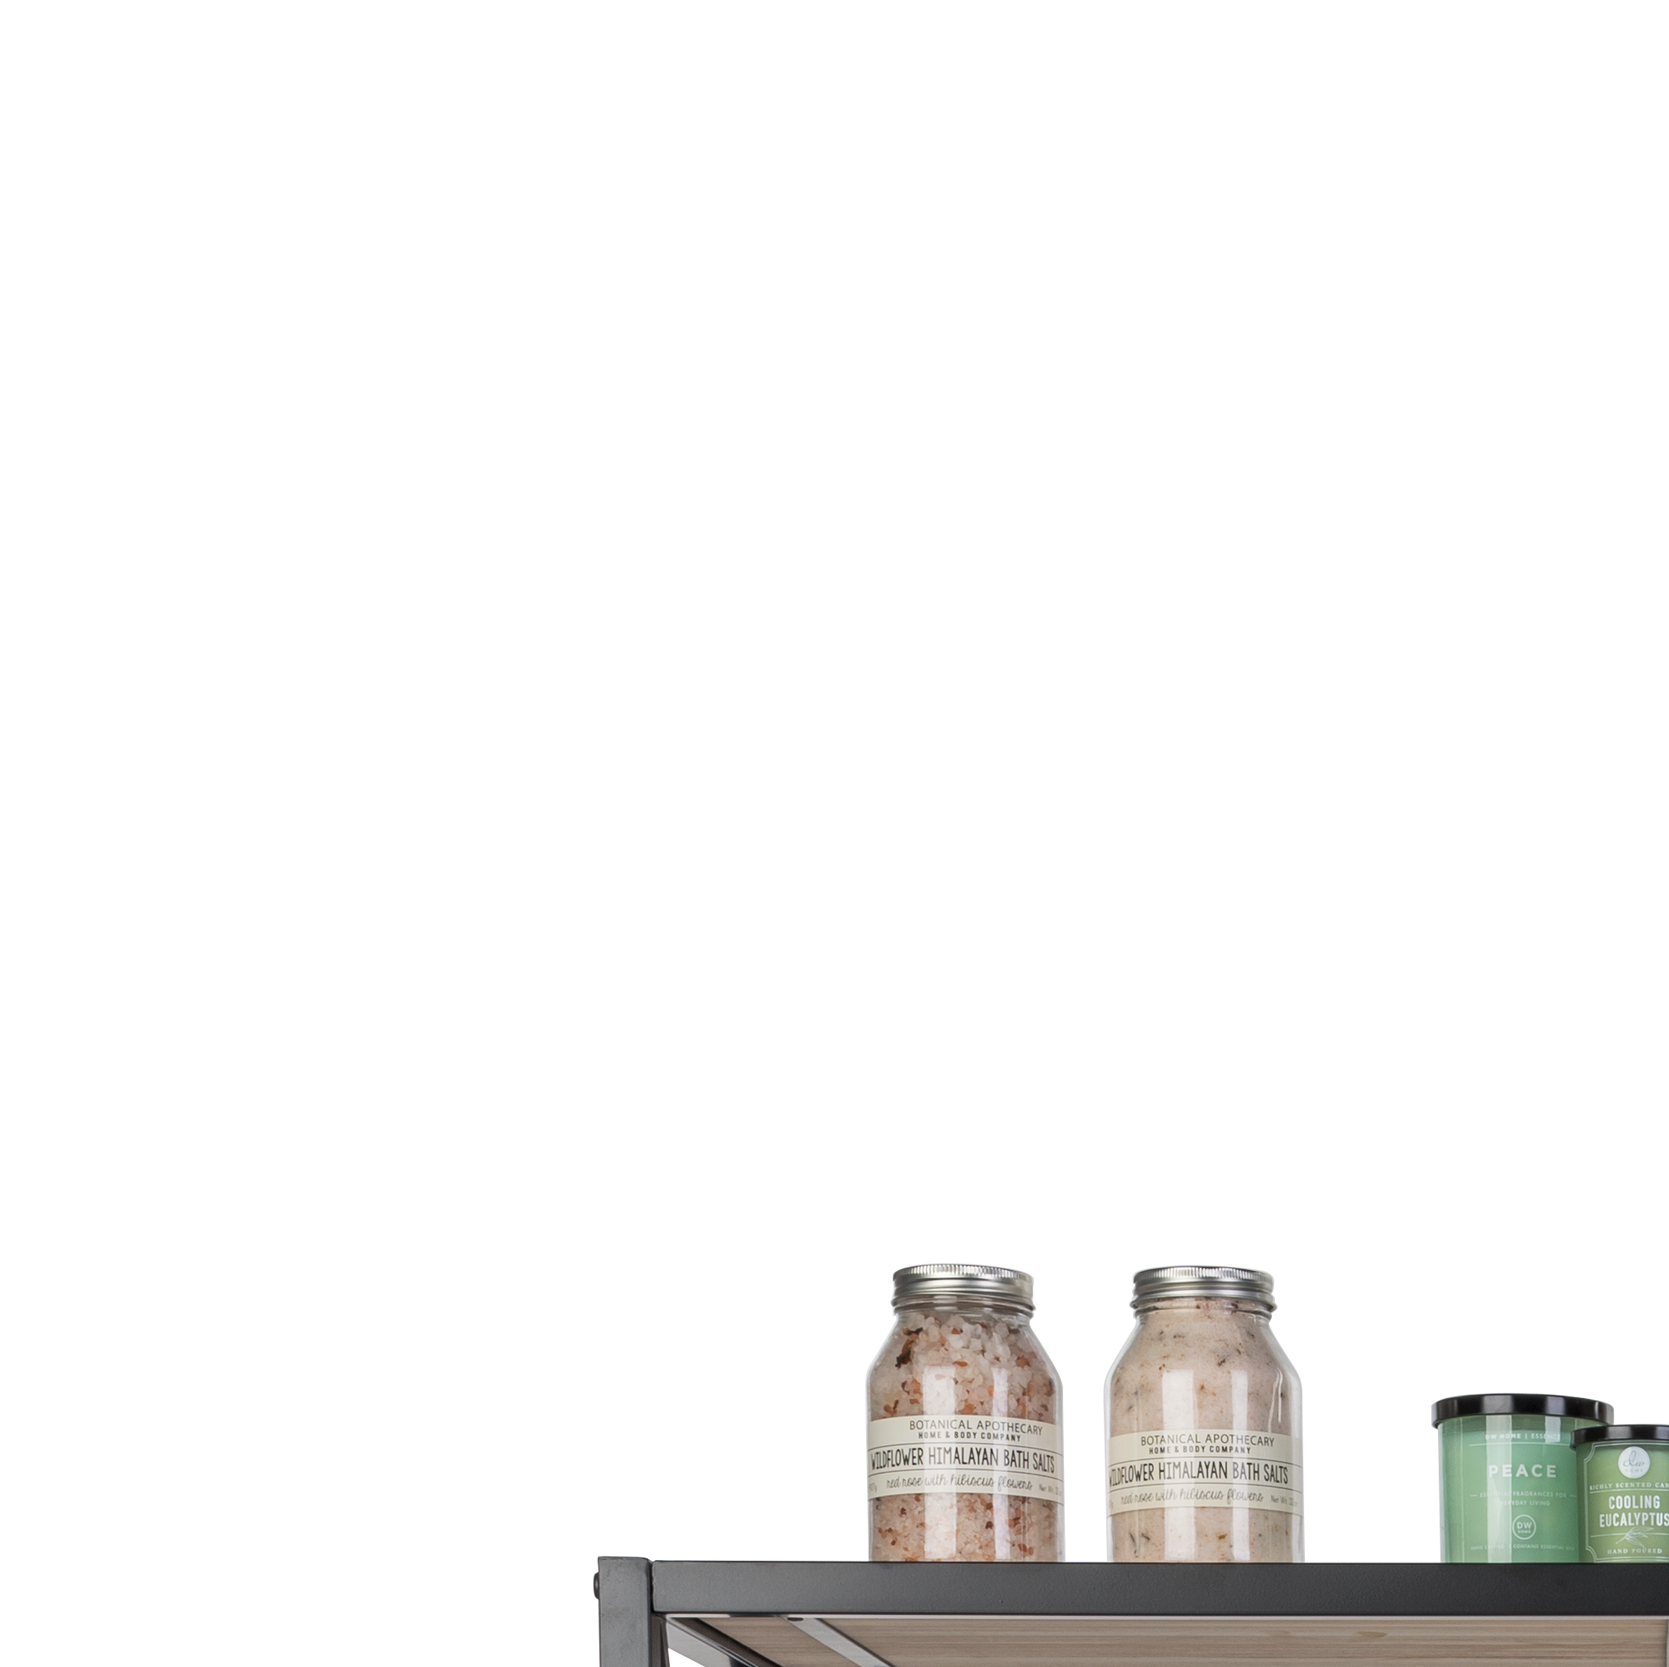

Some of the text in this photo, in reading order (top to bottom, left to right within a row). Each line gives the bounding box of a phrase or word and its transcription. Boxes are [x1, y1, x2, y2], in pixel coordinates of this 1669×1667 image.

[909, 1419, 1043, 1436] BOTANICAL APOTHECARY
[918, 1430, 942, 1439] HOME
[954, 1431, 978, 1440] BODY
[981, 1431, 1022, 1442] COMPANY
[1141, 1433, 1275, 1447] BOTANICAL APOTHECARY
[1149, 1447, 1171, 1455] HOME
[1183, 1446, 1205, 1454] BODY
[1209, 1446, 1251, 1454] COMPANY
[871, 1447, 1055, 1474] WILDFLOWER HIMALAYAN BATH SALTS
[1158, 1461, 1228, 1480] HIMALAYAN
[1232, 1461, 1260, 1481] BATH
[1263, 1463, 1289, 1484] SALTS
[1488, 1464, 1557, 1478] PEACE
[924, 1474, 948, 1487] with
[950, 1473, 995, 1488] hibiscus
[997, 1475, 1033, 1492] flowers
[1180, 1487, 1225, 1502] hibiscus
[1226, 1488, 1264, 1504] flowers
[1608, 1495, 1661, 1510] COOLING
[1516, 1521, 1533, 1529] DW
